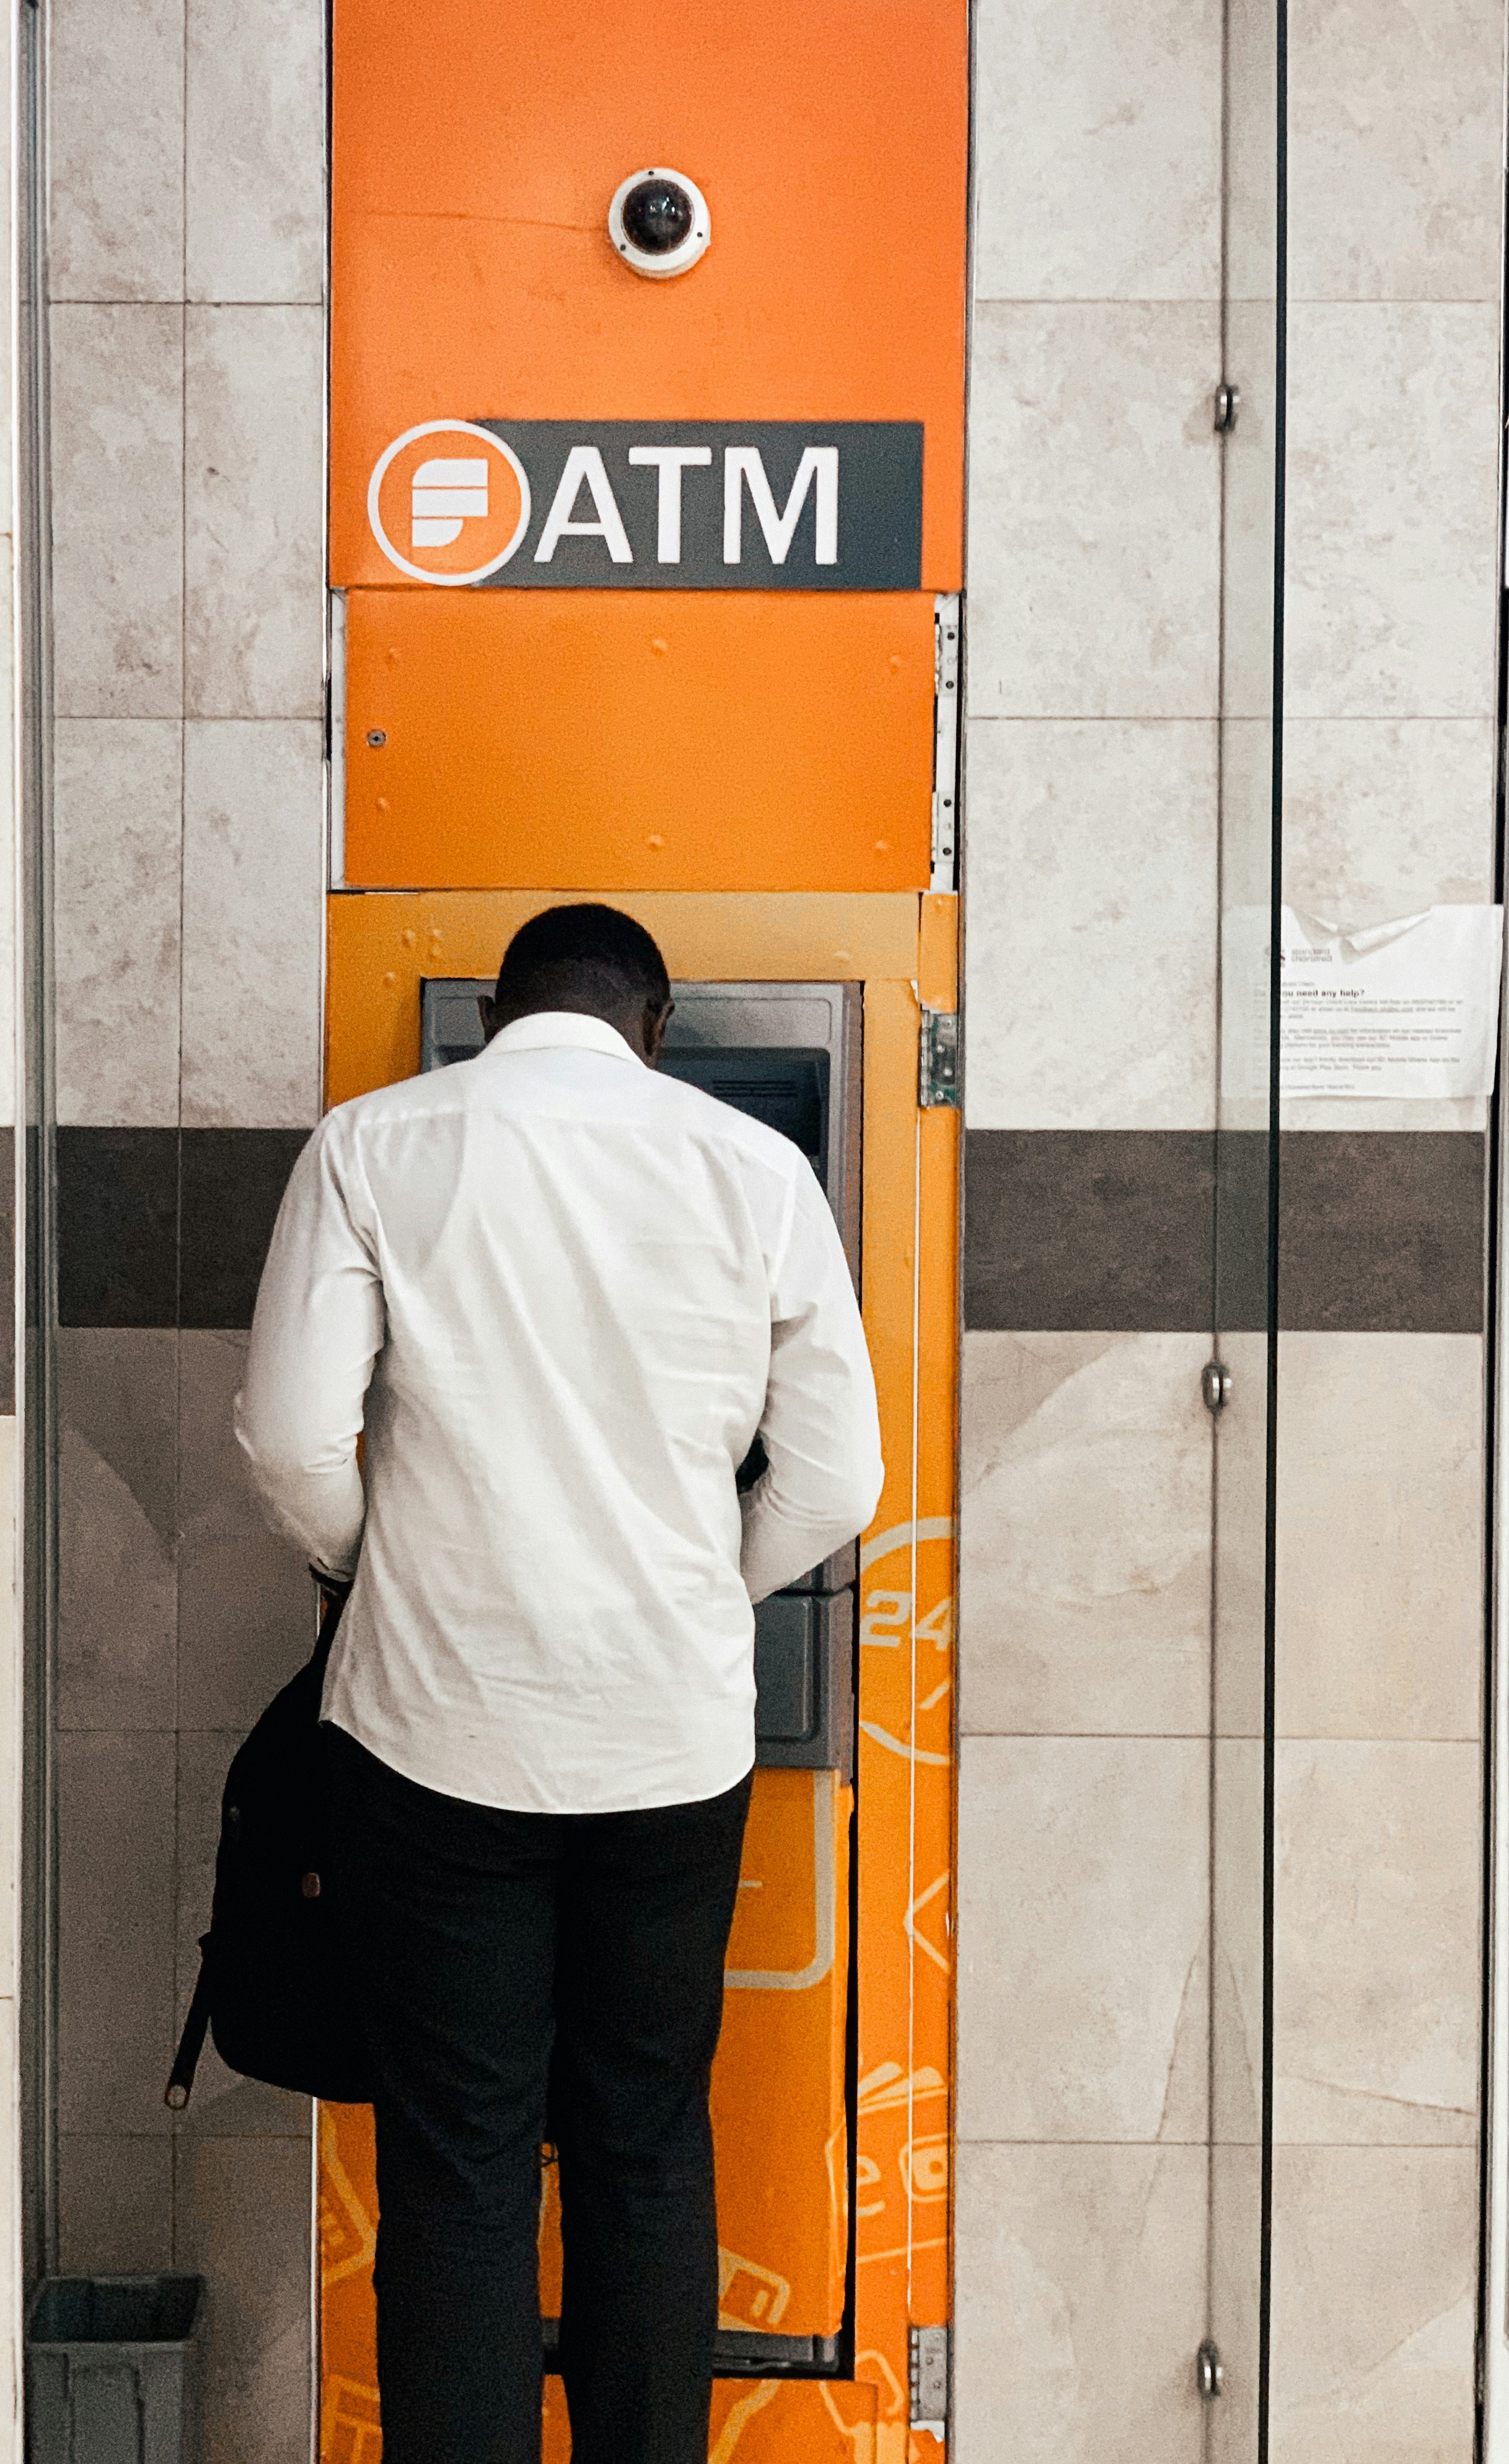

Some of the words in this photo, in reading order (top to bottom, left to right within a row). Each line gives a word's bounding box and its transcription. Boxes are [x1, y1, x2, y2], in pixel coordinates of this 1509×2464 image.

[534, 446, 838, 565] ATM
[1321, 990, 1337, 998] any
[860, 1590, 952, 1652] 24
